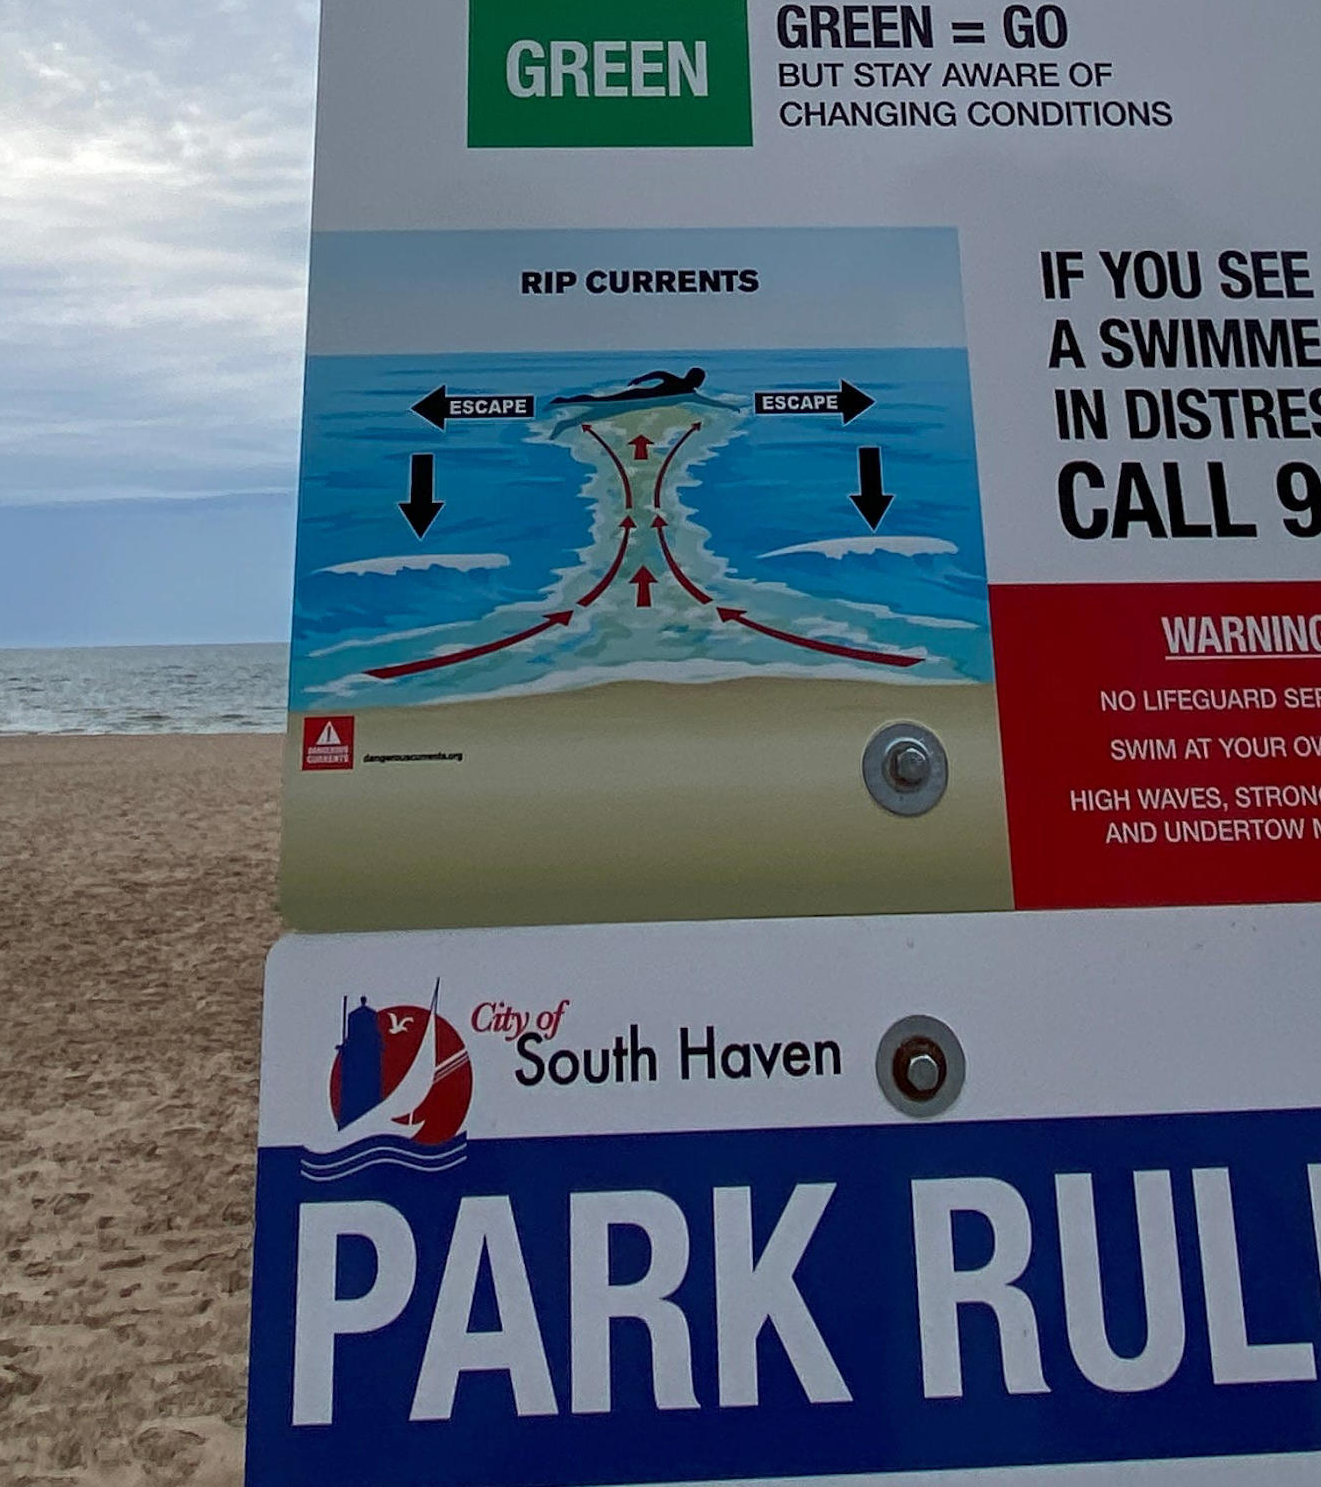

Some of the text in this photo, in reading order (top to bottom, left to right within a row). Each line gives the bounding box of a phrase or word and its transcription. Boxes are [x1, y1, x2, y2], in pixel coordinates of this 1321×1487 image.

[777, 5, 1067, 48] GREEN = GO
[507, 40, 708, 97] GREEN
[779, 62, 1112, 87] BUT STAY AWARE OF
[780, 101, 1172, 126] CHANGING CONDITIONS
[522, 270, 758, 293] RIP CURRENTS
[1041, 251, 1314, 299] IF YOU SEE
[1049, 320, 1086, 368] A
[449, 399, 528, 415] ESCAPE
[762, 394, 838, 410] ESCAPE
[1055, 390, 1107, 440] IN
[1059, 461, 1257, 539] CALL
[1101, 690, 1135, 711] NO
[1144, 689, 1276, 710] LIFEGUARD
[1111, 739, 1176, 760] SWIM
[1185, 738, 1212, 759] AT
[1219, 737, 1287, 758] YOUR
[1071, 790, 1130, 811] HIGH
[1137, 787, 1228, 811] WAVES,
[1106, 822, 1157, 843] AND
[1165, 819, 1304, 842] UNDERTOW
[471, 999, 569, 1042] City of
[515, 1023, 841, 1086] South Haven
[293, 1183, 853, 1425] PARK
